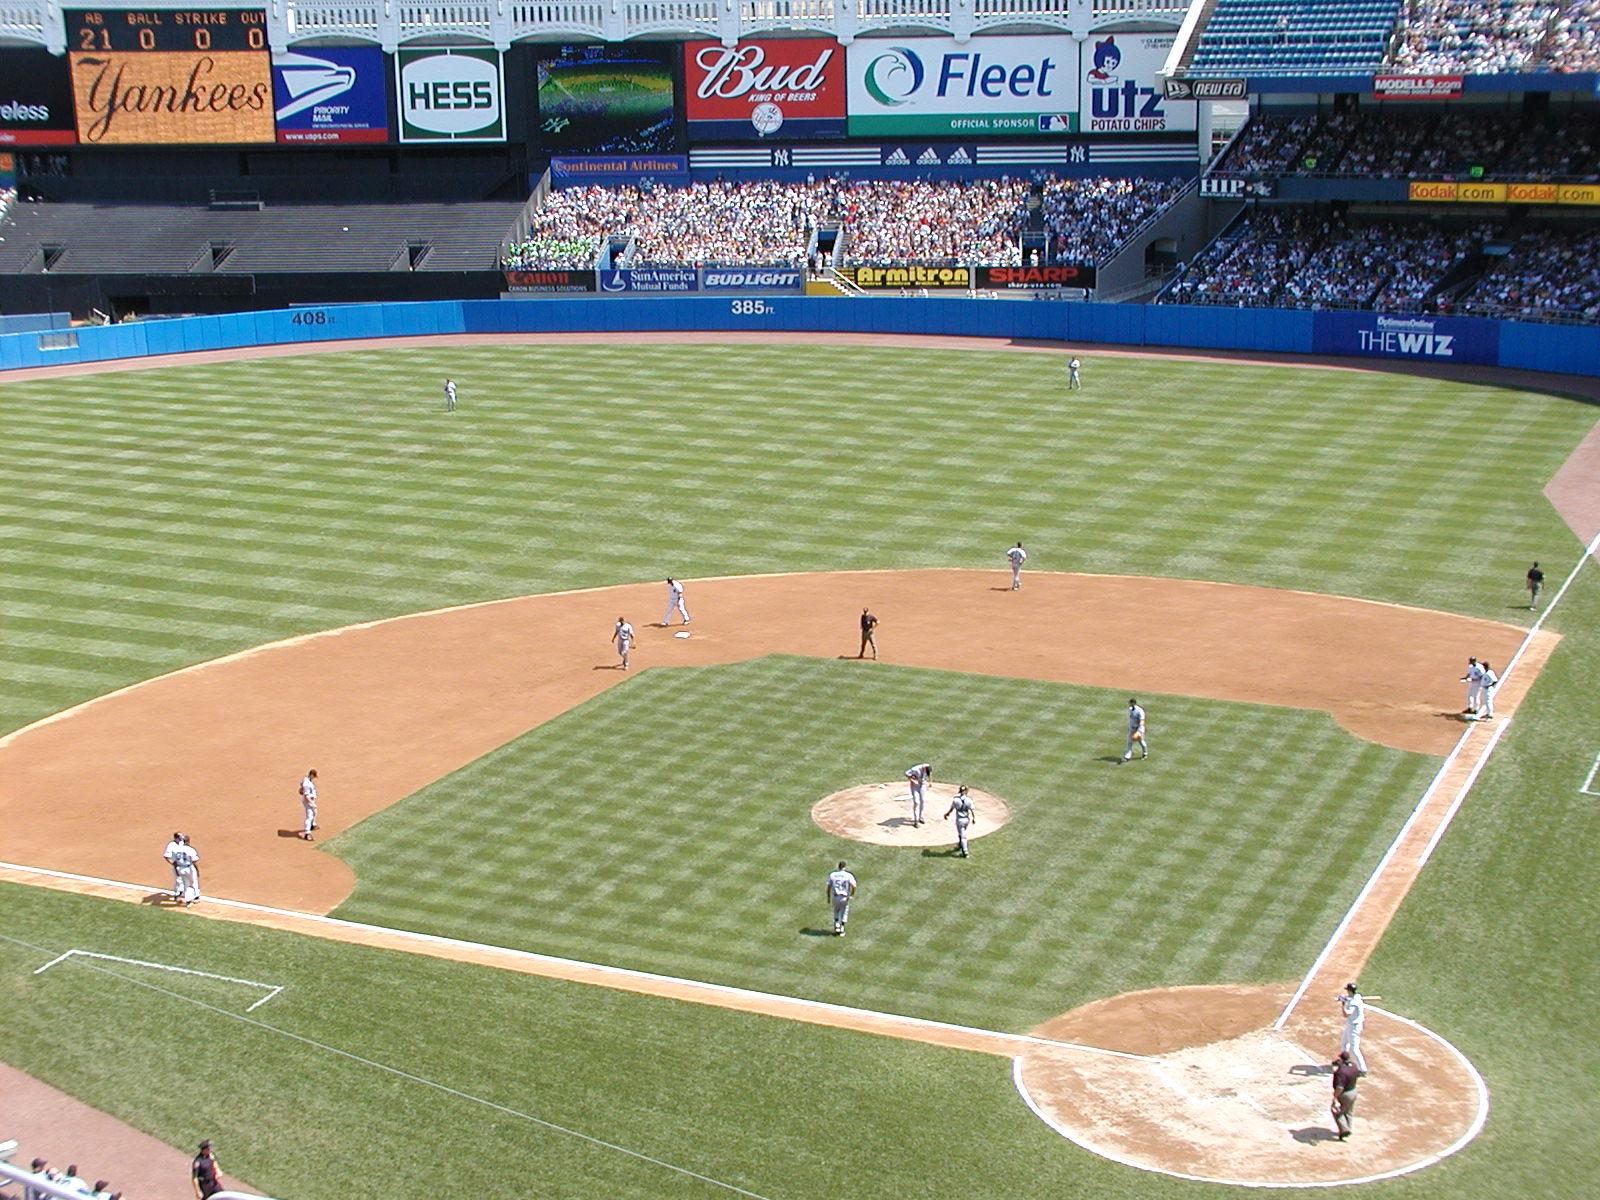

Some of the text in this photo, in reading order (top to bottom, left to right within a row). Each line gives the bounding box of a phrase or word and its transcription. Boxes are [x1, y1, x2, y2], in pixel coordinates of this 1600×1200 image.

[84, 12, 265, 25] AB BALL STRIKE OUT
[80, 28, 264, 50] 21 0 0 0
[695, 45, 834, 100] Bud
[936, 52, 1056, 98] Fleet
[76, 57, 270, 142] Yankees
[409, 81, 493, 110] HESS
[748, 94, 772, 102] KING
[787, 93, 817, 102] BEERS
[313, 106, 350, 114] PRIORITY
[312, 115, 333, 123] MAIL
[950, 119, 1035, 129] OFFICIAL SPONSOR
[1091, 118, 1166, 132] POTATO CHIPS
[285, 133, 340, 142] www.usps.com
[553, 160, 678, 173] Continental Airlines
[885, 158, 973, 166] adidas adidas adidas
[1201, 178, 1246, 194] HIP
[508, 271, 569, 285] Canon
[630, 270, 696, 282] SunAmerica
[857, 266, 969, 282] Armitron
[989, 267, 1079, 283] SHARP
[631, 282, 689, 291] Mutual Funds
[731, 300, 764, 315] 385
[292, 311, 326, 325] 408
[1358, 330, 1454, 356] THE WIZ
